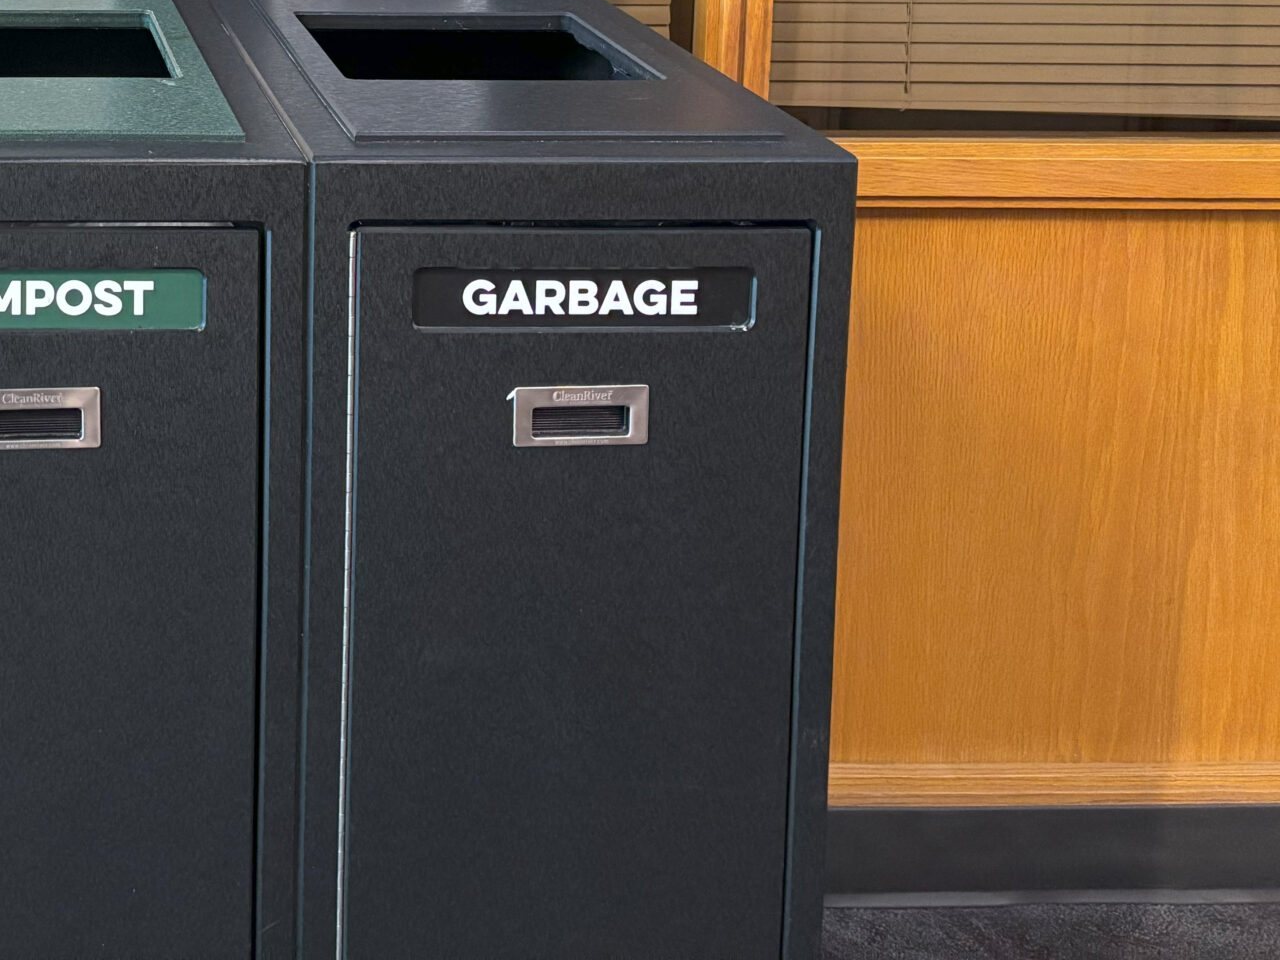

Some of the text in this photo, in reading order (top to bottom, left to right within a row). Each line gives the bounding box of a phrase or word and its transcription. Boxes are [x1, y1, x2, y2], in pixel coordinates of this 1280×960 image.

[462, 279, 699, 316] GARBAGE
[1, 392, 63, 404] CleanRiver
[552, 390, 613, 402] CleanRiver
